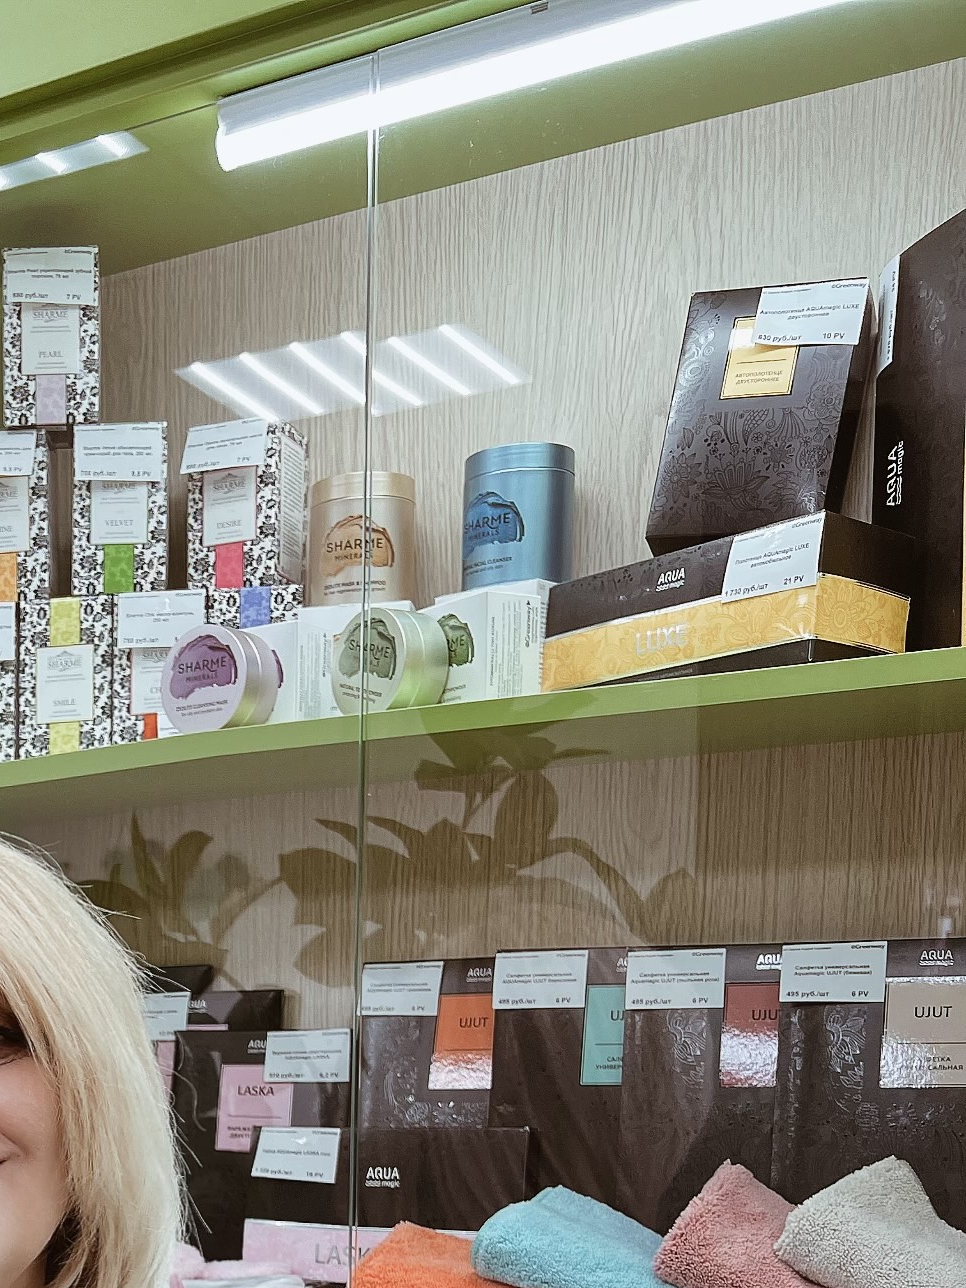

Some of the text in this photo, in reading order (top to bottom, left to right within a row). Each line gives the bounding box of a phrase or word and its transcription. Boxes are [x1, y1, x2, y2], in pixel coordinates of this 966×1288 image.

[887, 446, 897, 506] AQUA
[657, 567, 686, 585] AQUA
[793, 575, 805, 583] PV
[635, 623, 688, 656] LUXE
[177, 656, 226, 674] SHARME
[920, 949, 954, 960] AQUA
[467, 967, 492, 978] AQUA
[801, 990, 830, 998] руб./шт
[611, 1010, 625, 1021] UJ
[751, 1009, 779, 1021] UJU
[914, 1006, 953, 1018] UJUT
[459, 1017, 489, 1028] UJUT
[248, 1039, 267, 1049] AQU
[237, 1085, 275, 1096] LASKA
[366, 1166, 400, 1180] AQUA
[381, 1180, 400, 1189] magic
[315, 1243, 371, 1266] LASK
